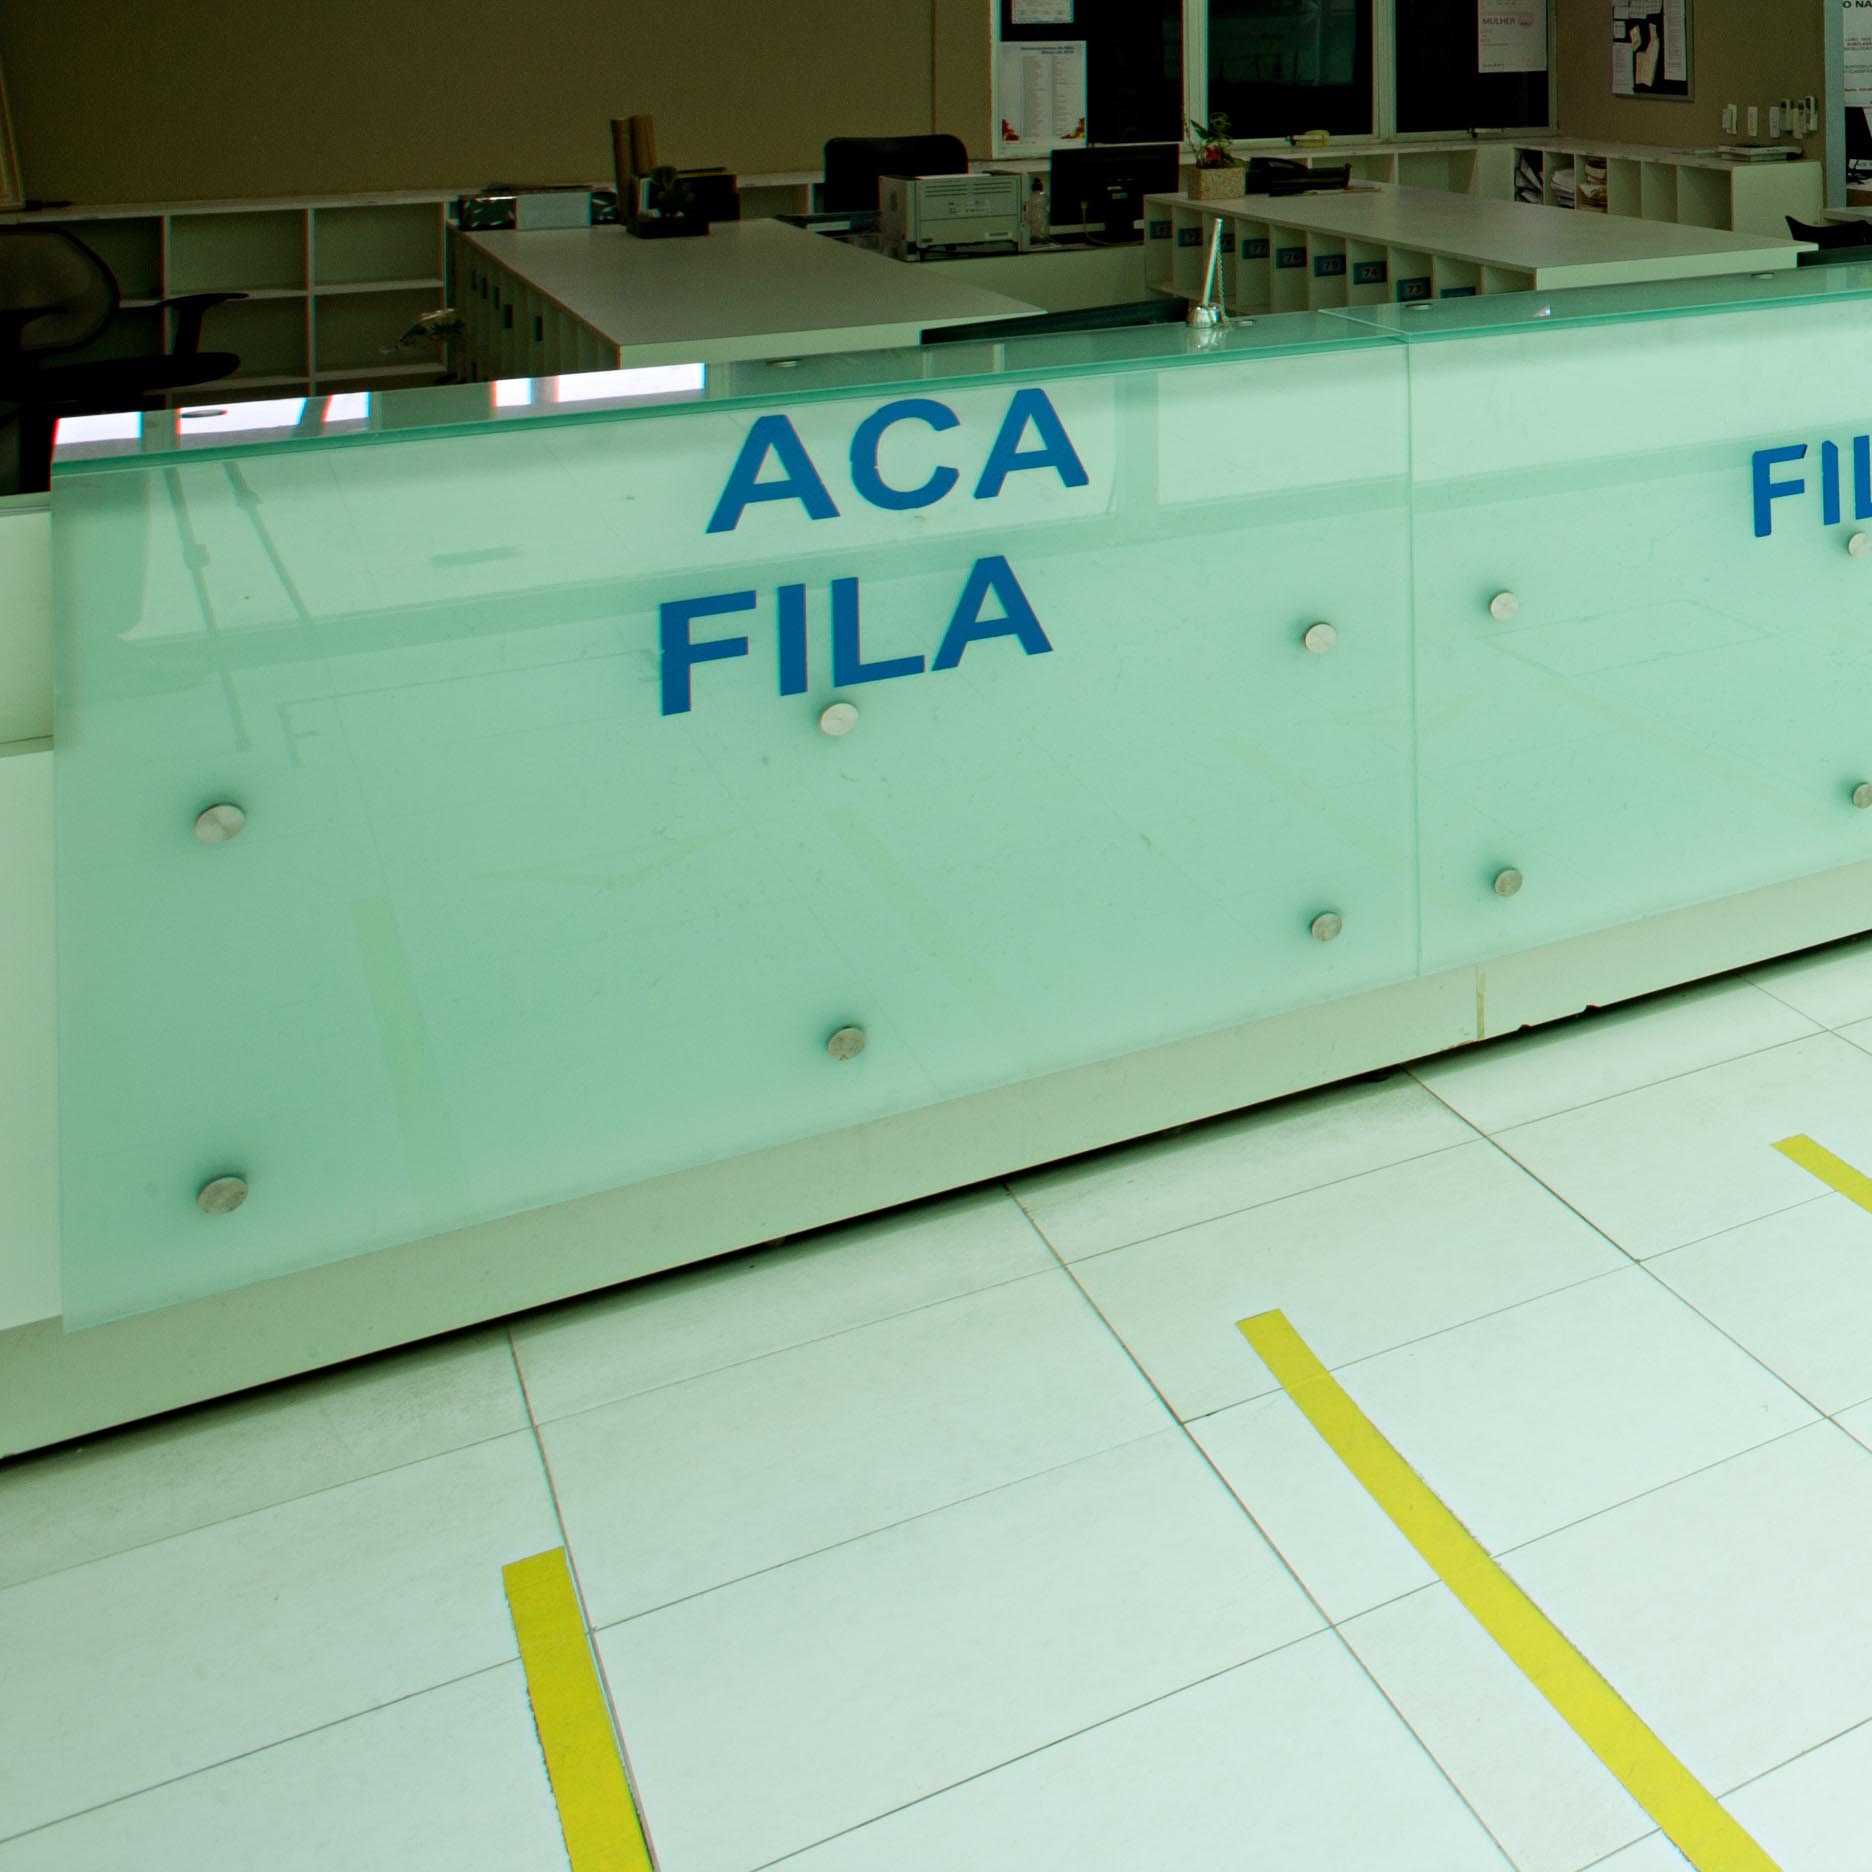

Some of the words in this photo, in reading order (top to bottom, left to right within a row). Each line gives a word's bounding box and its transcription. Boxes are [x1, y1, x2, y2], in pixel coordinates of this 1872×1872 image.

[1855, 0, 1872, 8] NA
[705, 387, 1089, 535] ACA
[659, 554, 1054, 717] FILA
